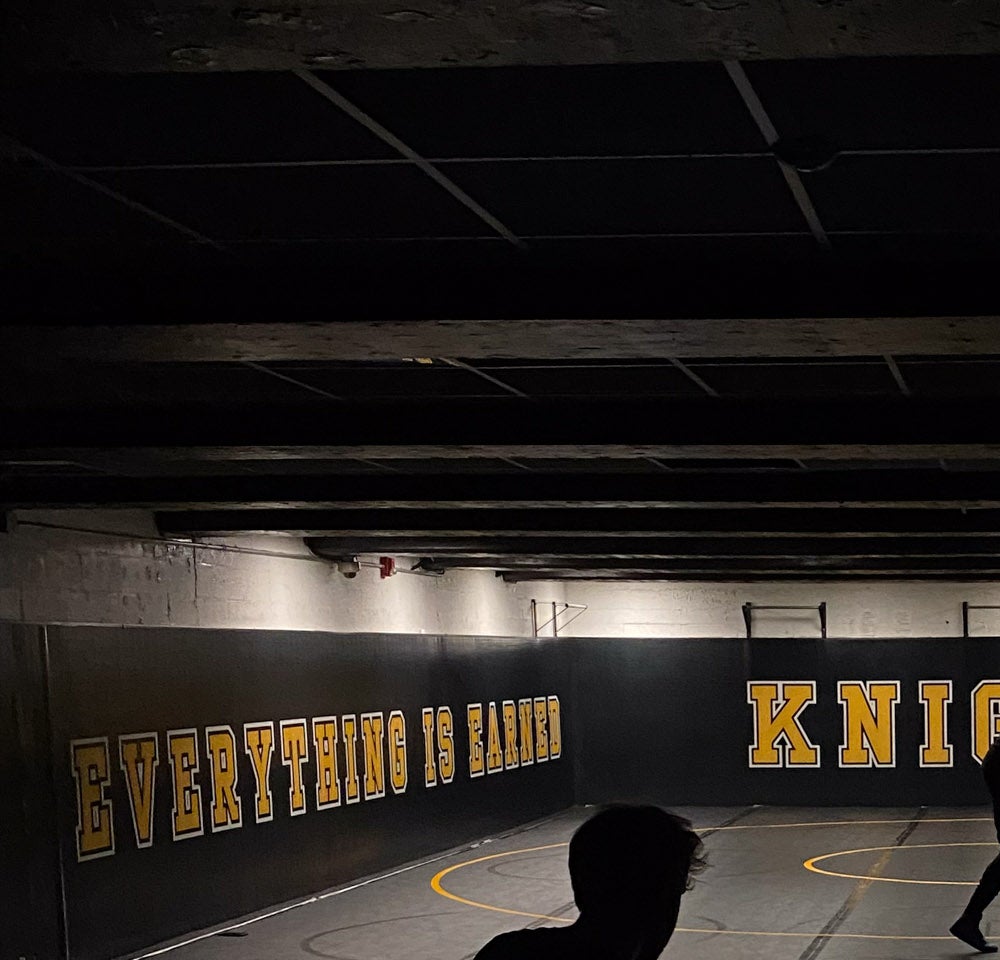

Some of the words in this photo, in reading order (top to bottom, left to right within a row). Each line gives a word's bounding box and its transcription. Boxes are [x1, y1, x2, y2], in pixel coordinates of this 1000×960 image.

[70, 710, 408, 862] EVERYTHING
[421, 705, 455, 788] IS
[467, 695, 562, 778] EARNED
